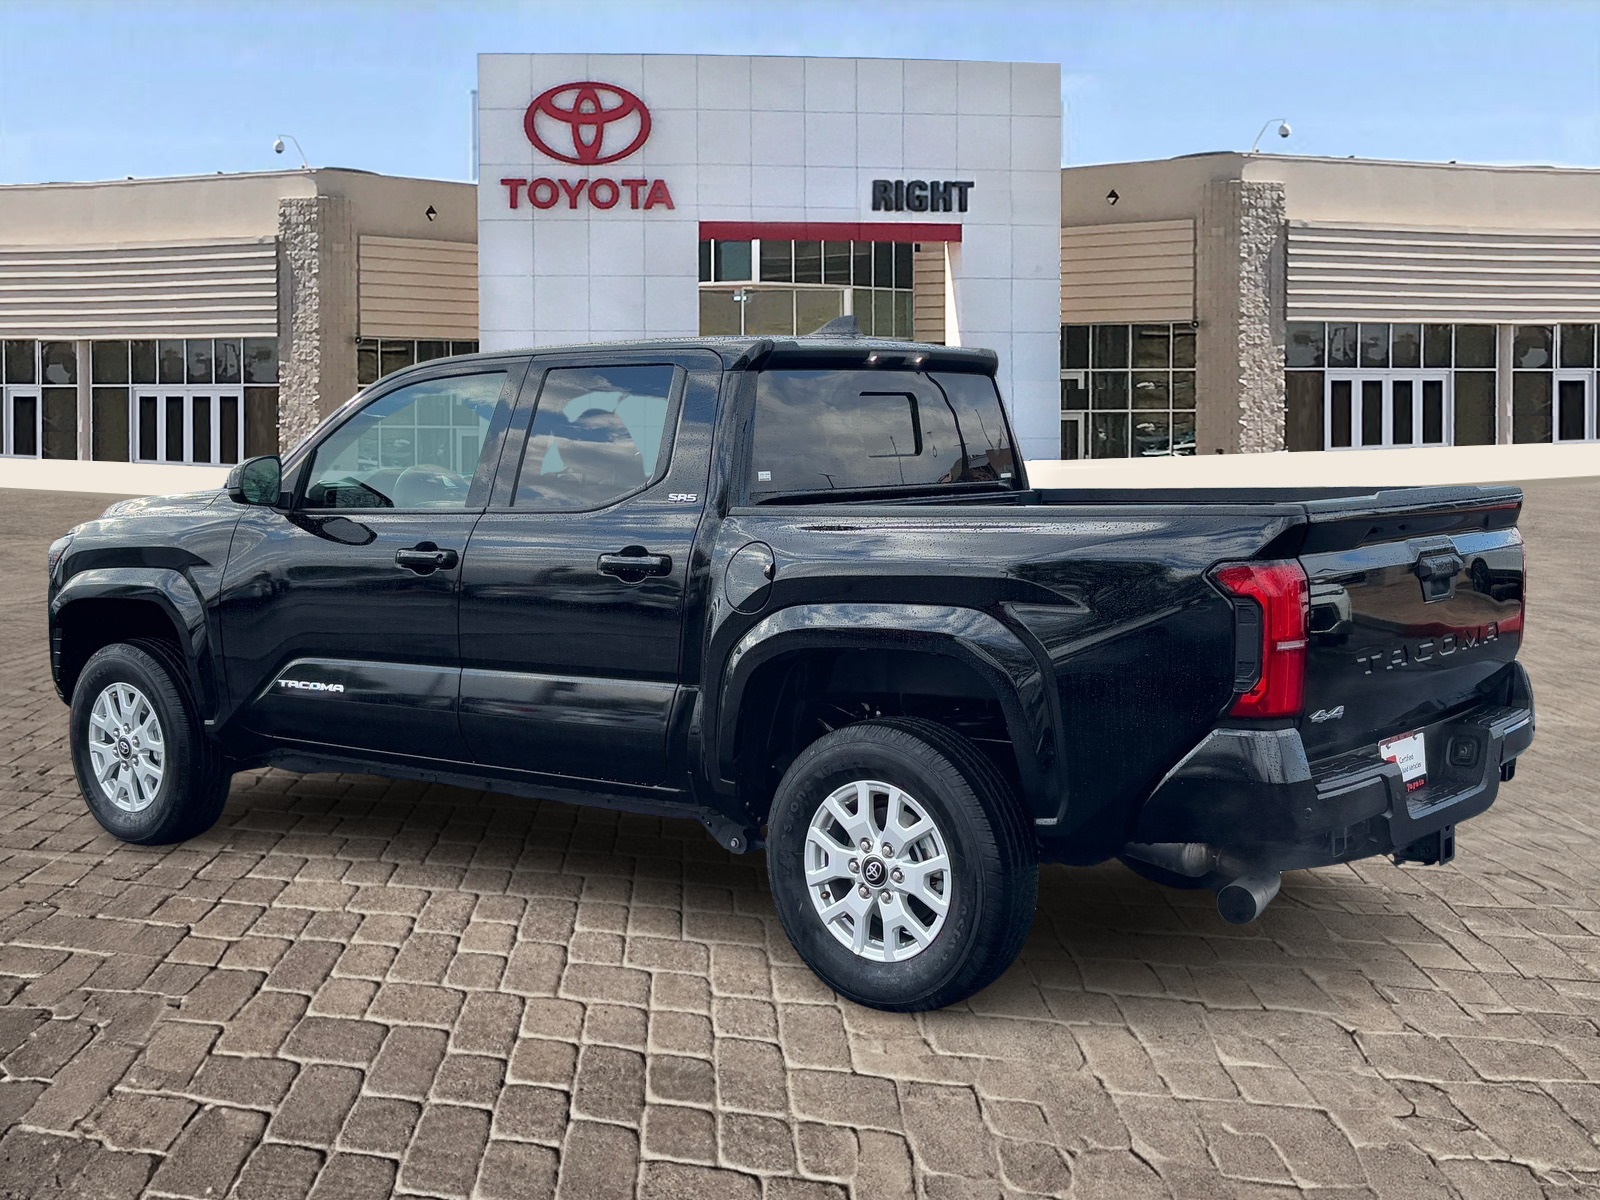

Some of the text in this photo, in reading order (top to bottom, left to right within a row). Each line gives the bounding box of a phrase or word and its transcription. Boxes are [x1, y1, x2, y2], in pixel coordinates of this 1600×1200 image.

[500, 177, 675, 210] TOYOTA
[872, 179, 975, 212] RIGHT
[668, 493, 698, 503] SR5
[1356, 621, 1499, 675] TACOMA
[278, 679, 345, 693] TACOMA
